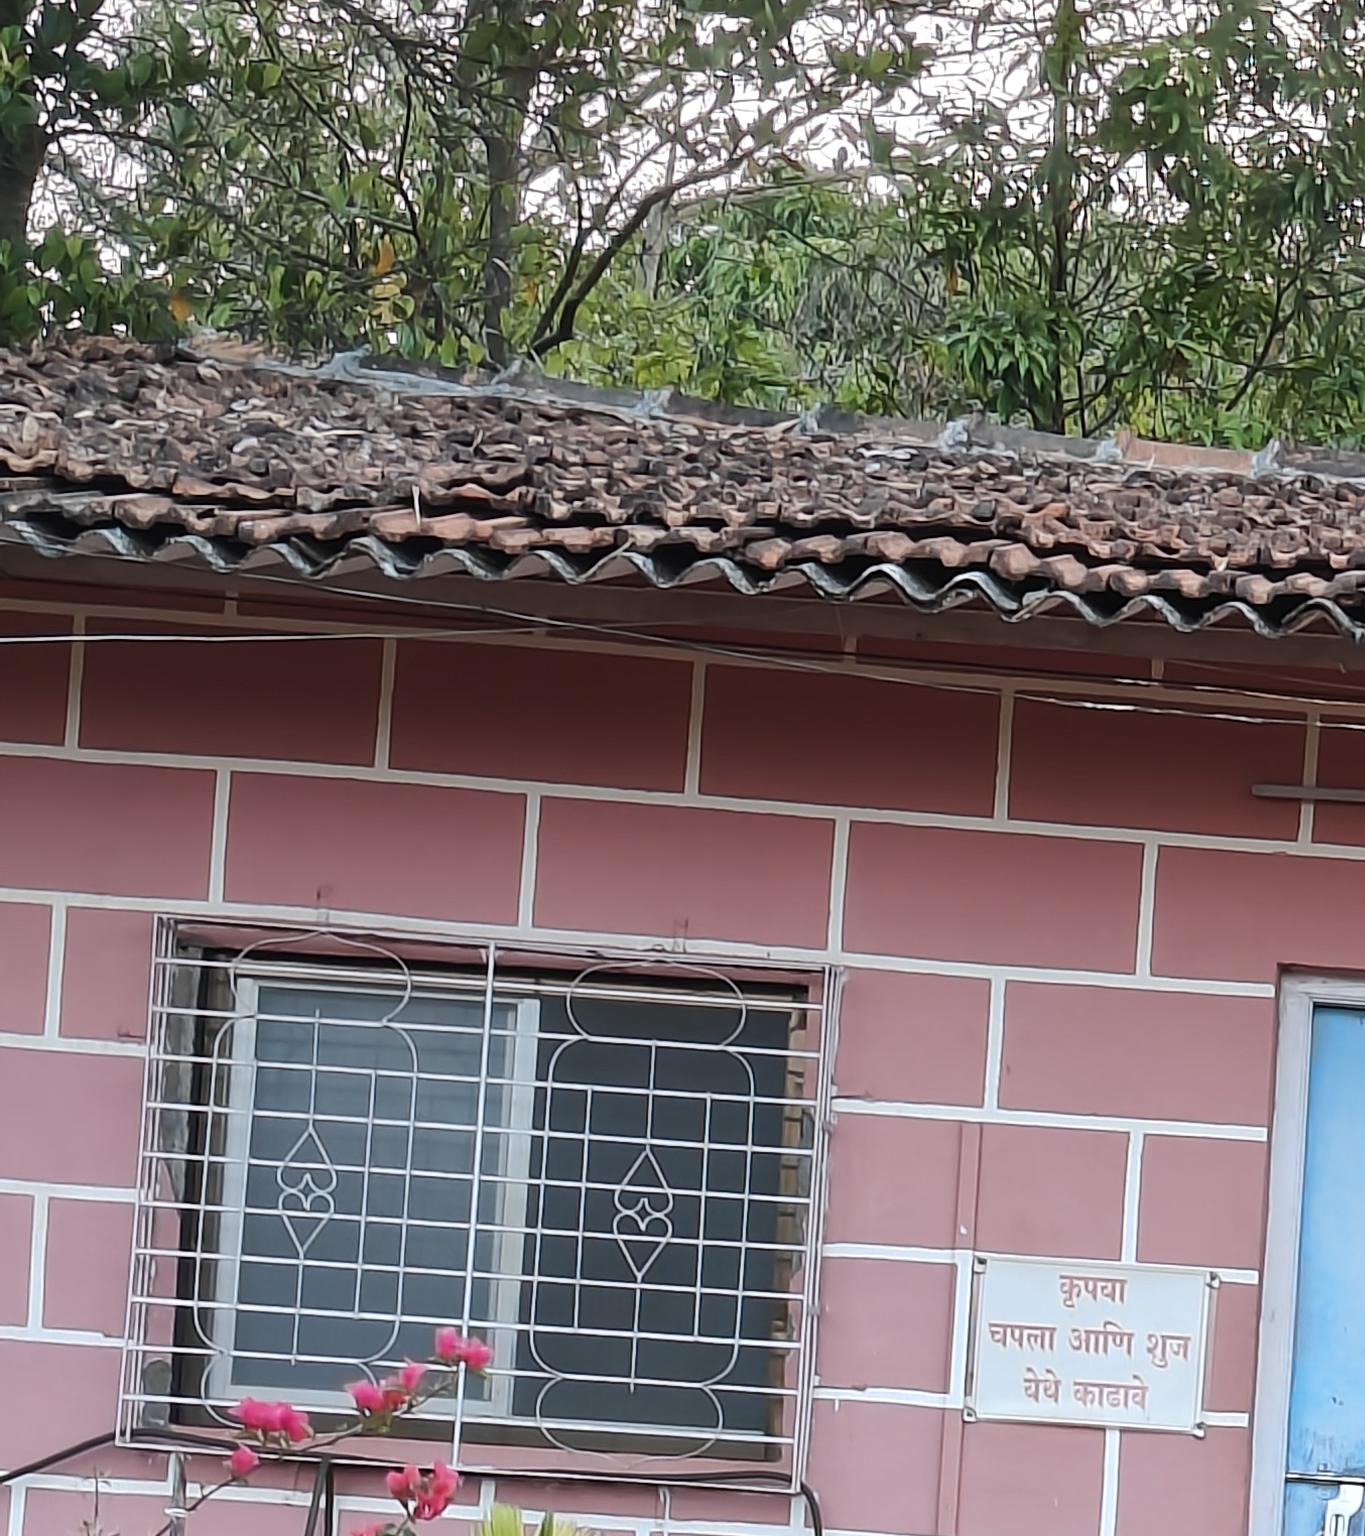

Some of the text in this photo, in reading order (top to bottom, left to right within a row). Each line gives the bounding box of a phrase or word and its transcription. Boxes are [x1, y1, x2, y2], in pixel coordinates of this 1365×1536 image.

[1059, 1274, 1128, 1309] कृपया
[988, 1320, 1192, 1368] चपला आणि शुज
[1023, 1366, 1149, 1411] येथे काढावे
